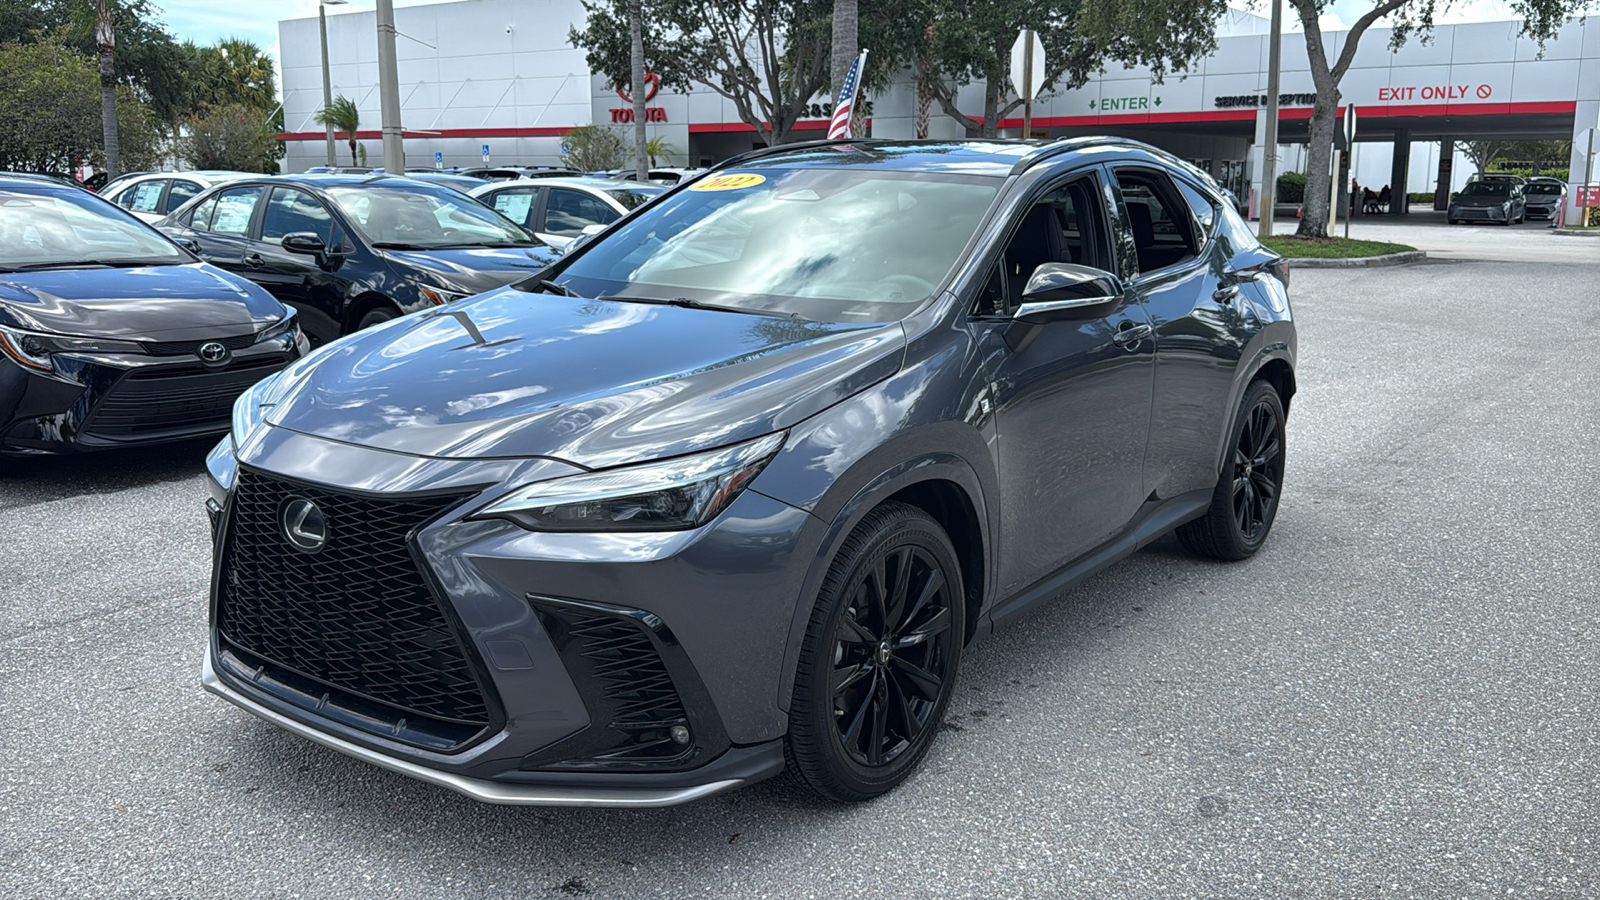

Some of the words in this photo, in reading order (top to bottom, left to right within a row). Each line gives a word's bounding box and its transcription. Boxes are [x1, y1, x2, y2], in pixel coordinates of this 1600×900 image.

[1378, 86, 1417, 101] EXIT
[1420, 85, 1469, 100] ONLY
[1101, 97, 1148, 111] ENTER
[1214, 95, 1259, 108] SERVICE
[1261, 93, 1317, 106] RCEPTION
[697, 176, 757, 188] 2022
